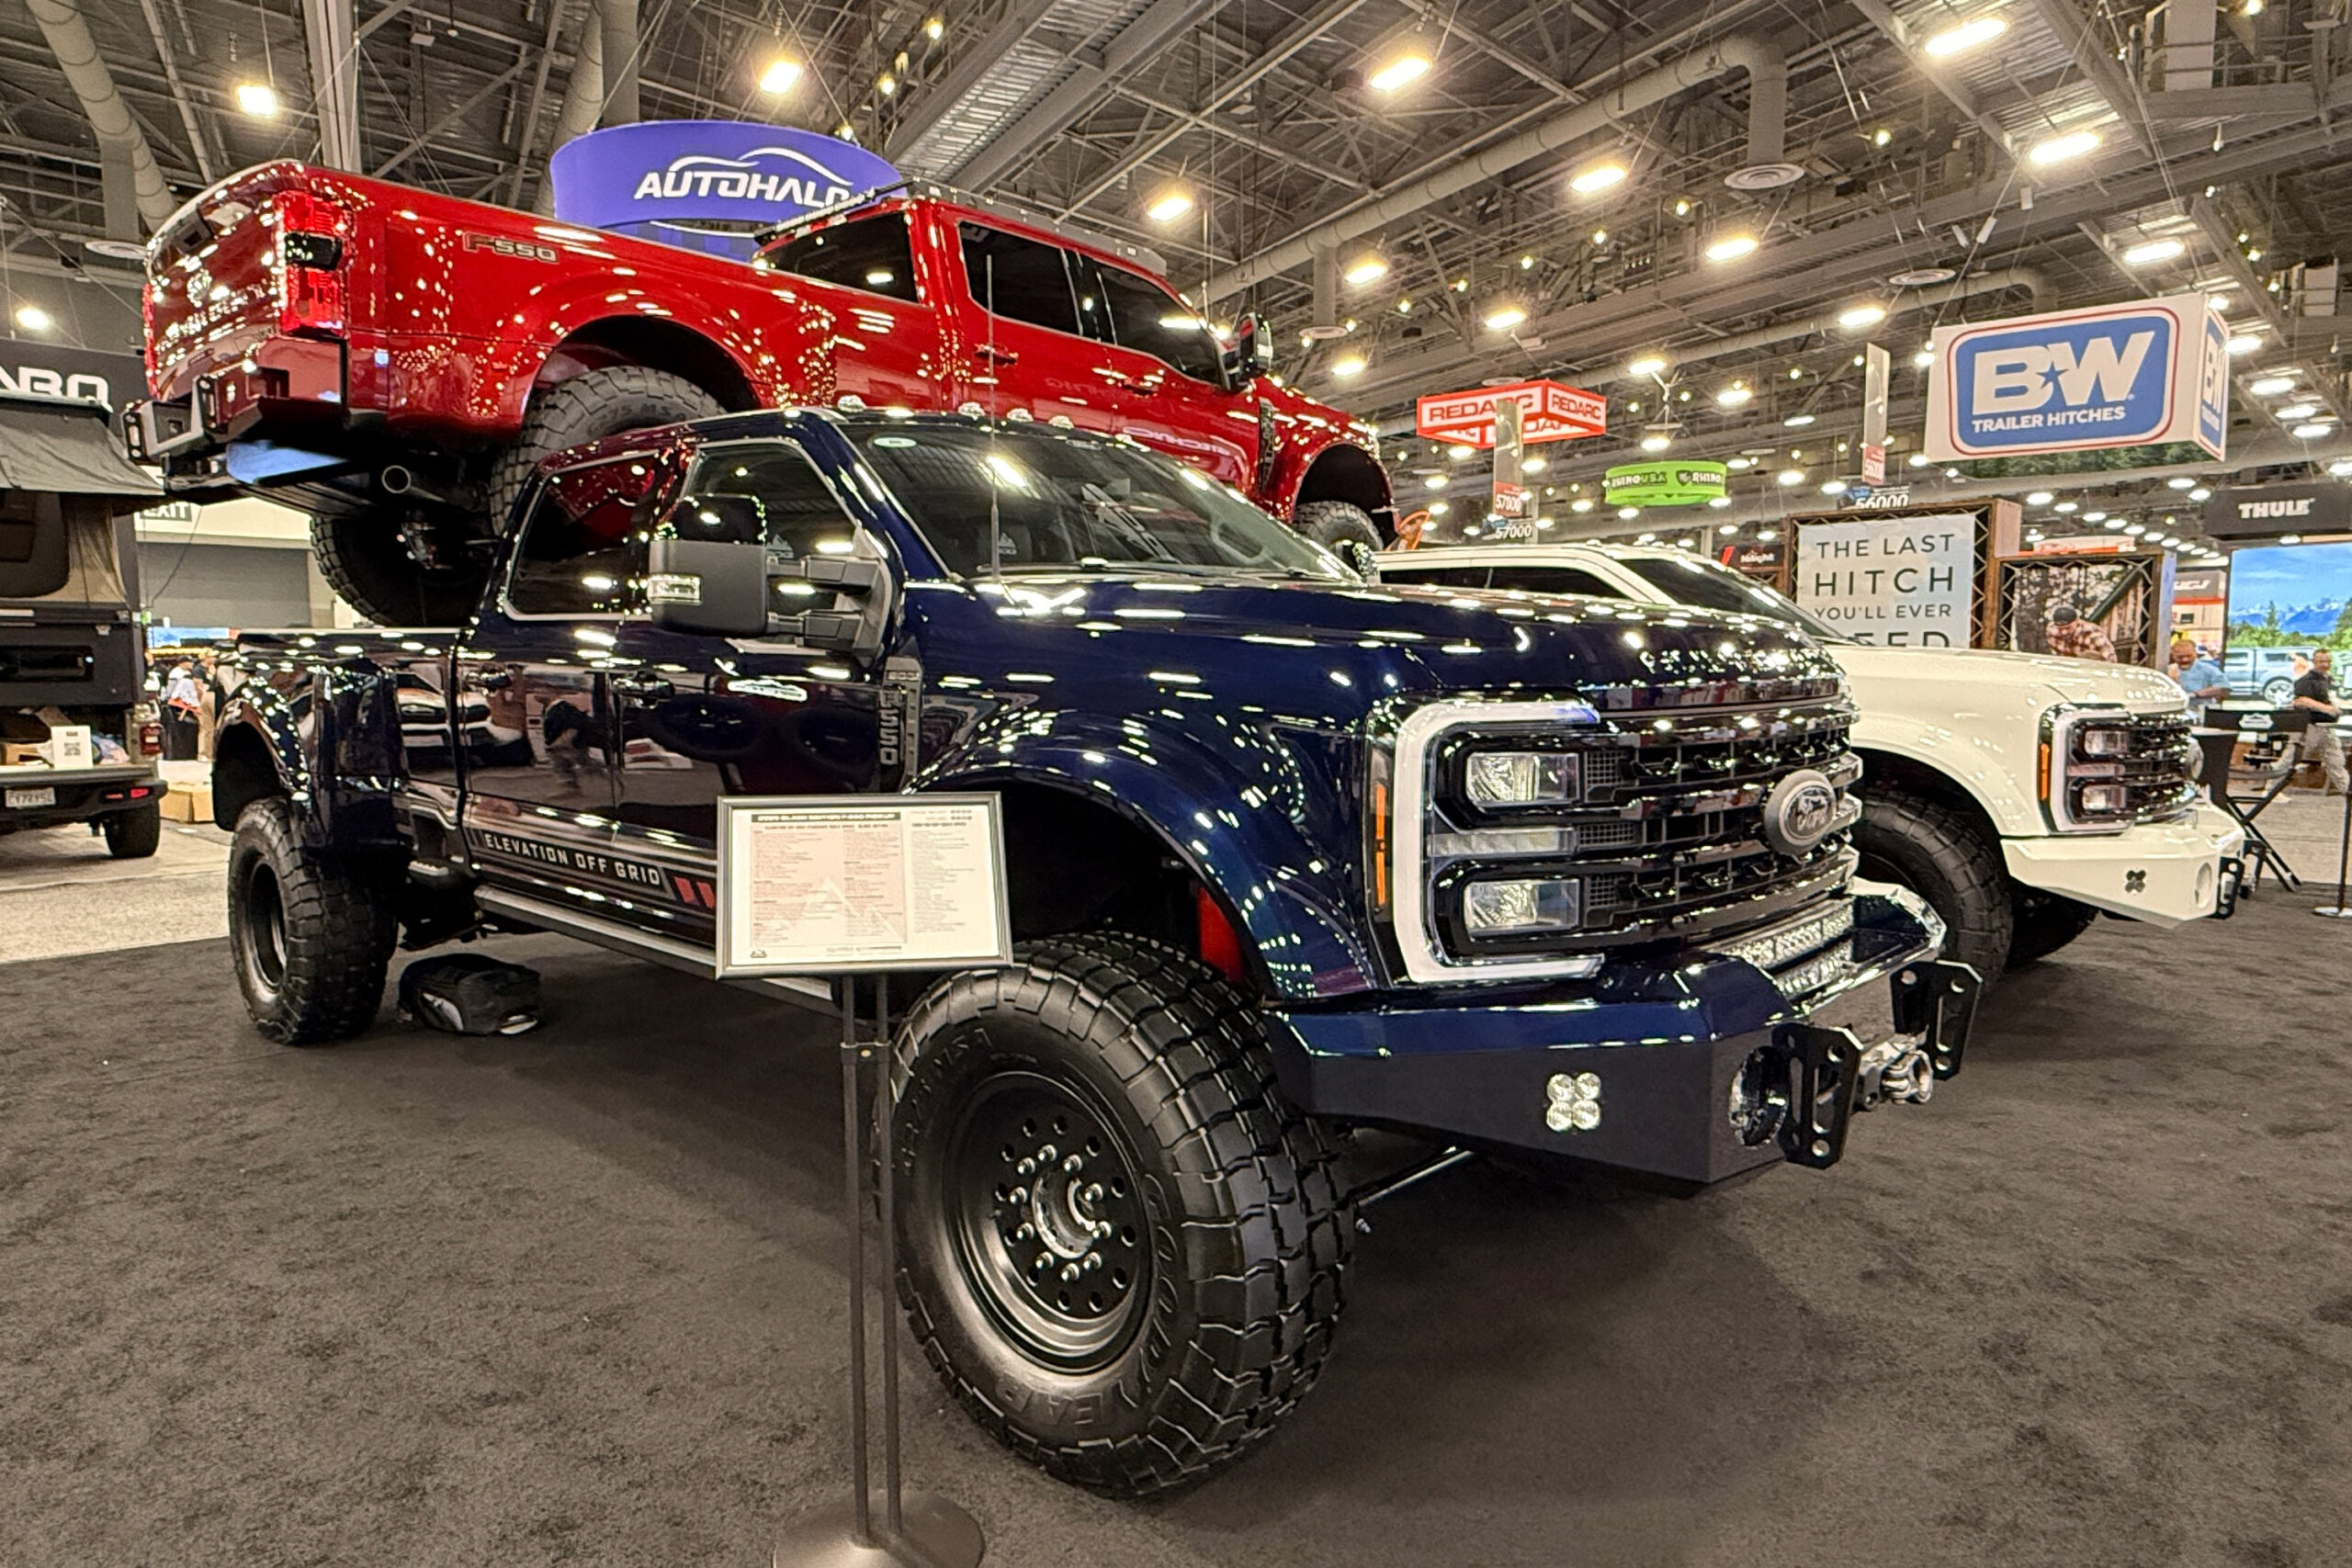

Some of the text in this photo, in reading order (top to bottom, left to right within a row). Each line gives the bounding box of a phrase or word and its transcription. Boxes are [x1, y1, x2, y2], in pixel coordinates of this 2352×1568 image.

[1429, 393, 1533, 422] REDAC
[1551, 394, 1601, 421] REDARC
[1972, 406, 2126, 433] TRAILER HITCHES
[2238, 499, 2310, 519] THULE
[1495, 525, 1532, 539] 57000
[1816, 534, 1955, 558] THE LAST
[1815, 566, 1954, 597] HITCH
[1815, 604, 1952, 620] YOU'LL EVER
[484, 833, 662, 886] ELEVATION OFF GRID
